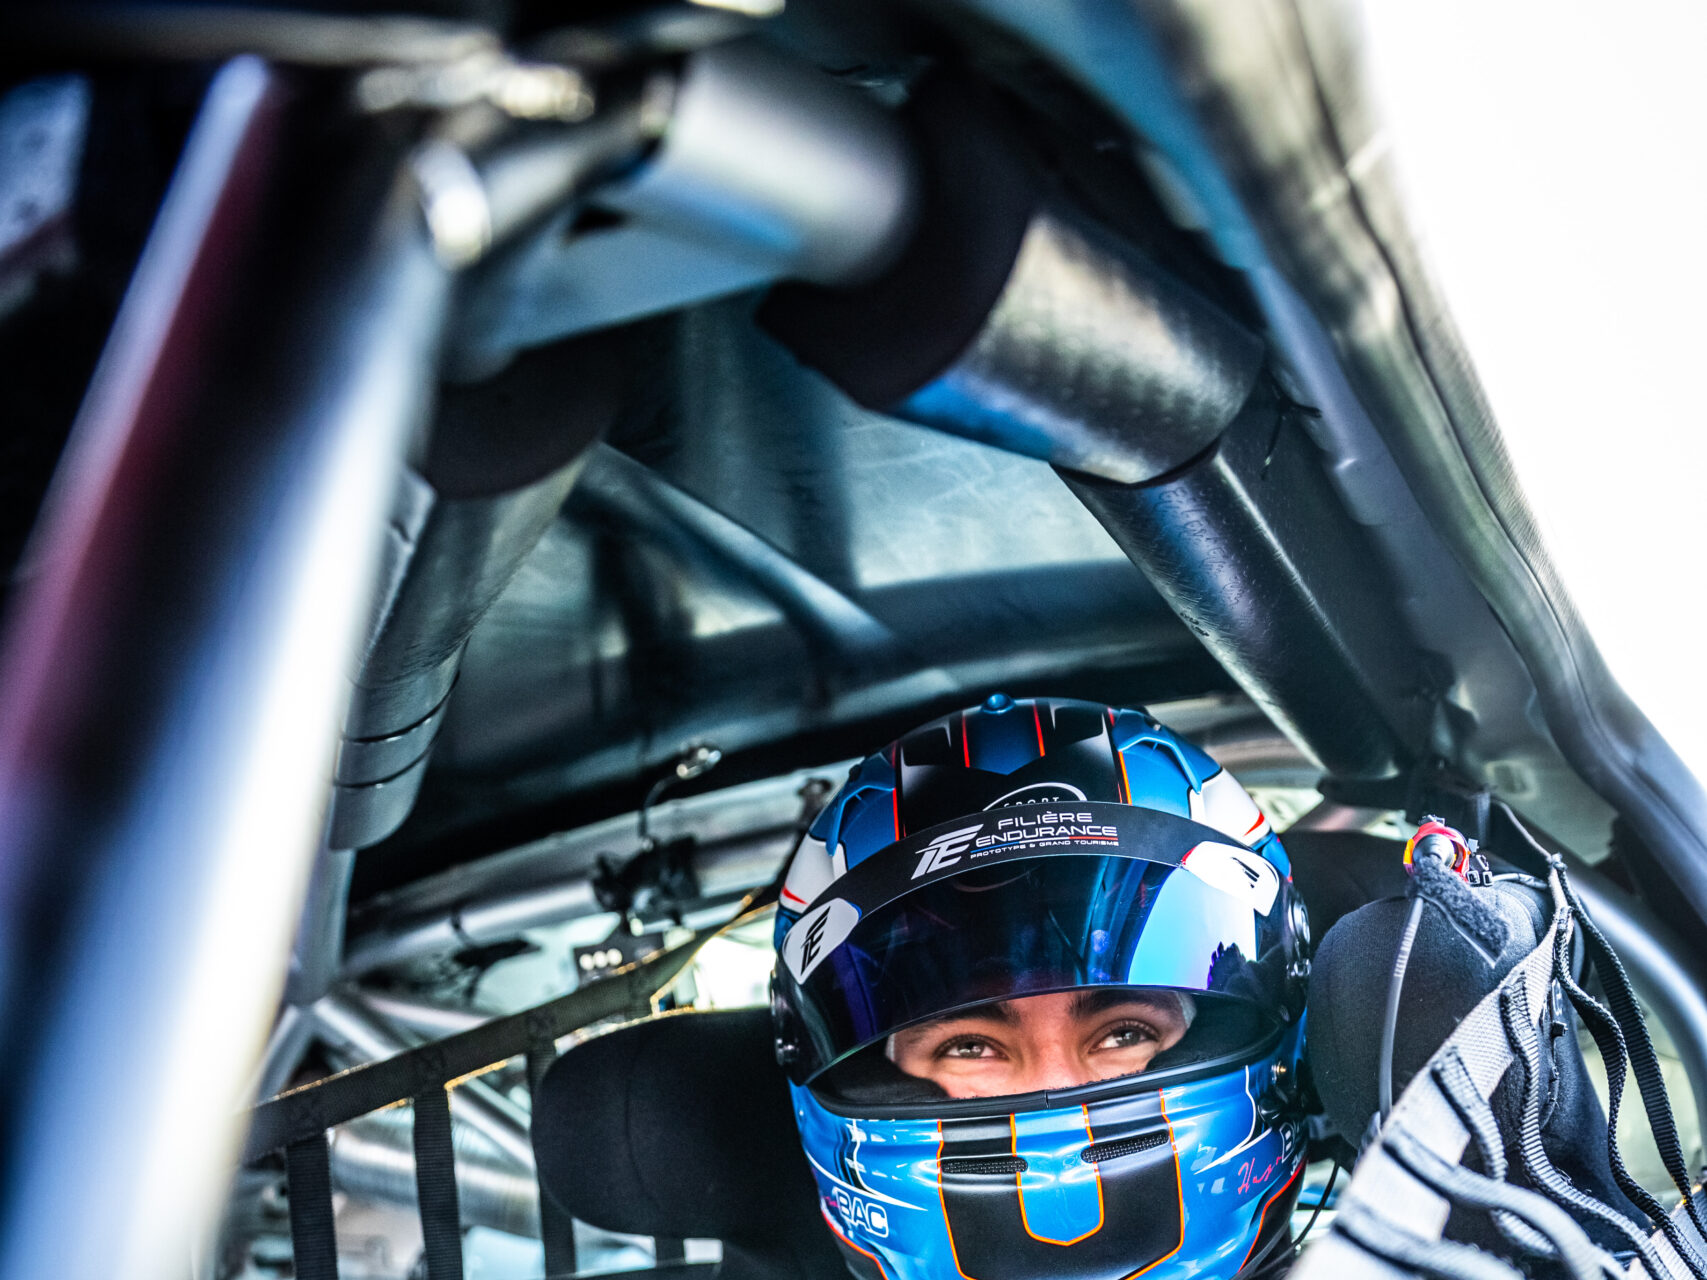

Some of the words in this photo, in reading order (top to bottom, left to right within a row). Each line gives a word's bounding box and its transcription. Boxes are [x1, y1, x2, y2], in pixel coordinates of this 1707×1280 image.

[997, 811, 1093, 830] FILIÈRE
[975, 825, 1118, 848] ENDURANCE
[970, 844, 1026, 859] PROTOTYPE
[1074, 839, 1120, 847] TOURISME
